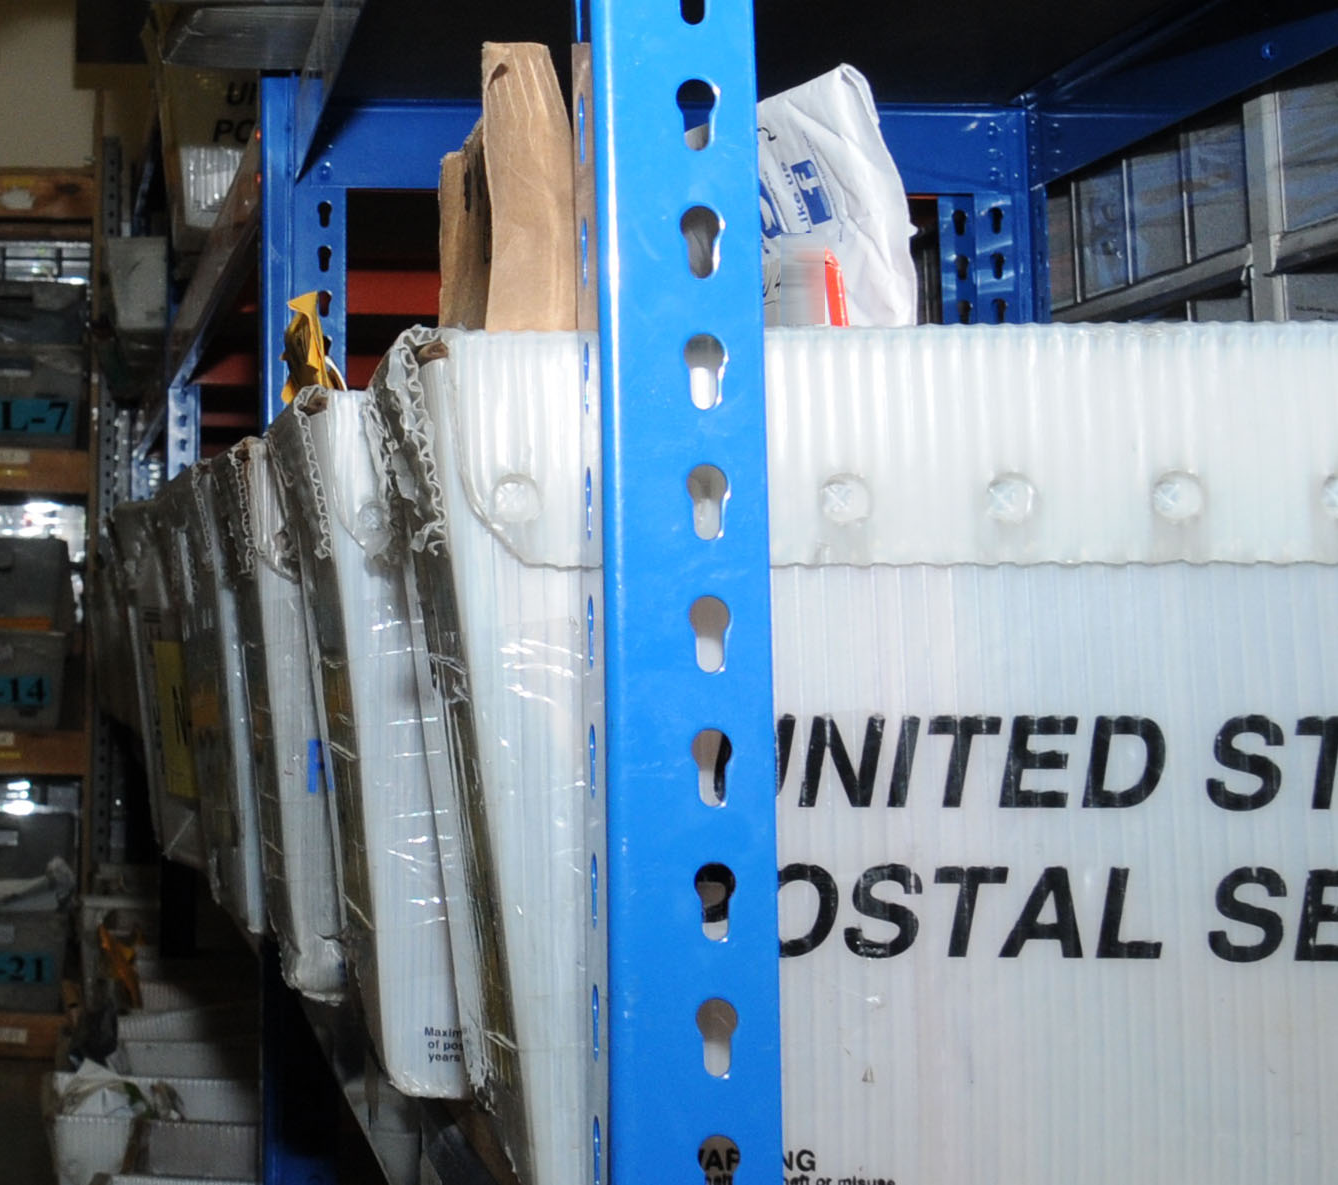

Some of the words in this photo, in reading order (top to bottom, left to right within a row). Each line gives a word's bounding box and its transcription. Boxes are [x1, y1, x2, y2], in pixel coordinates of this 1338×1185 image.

[778, 862, 1162, 959] OSTAL
[428, 1040, 440, 1049] of
[428, 1053, 461, 1064] years
